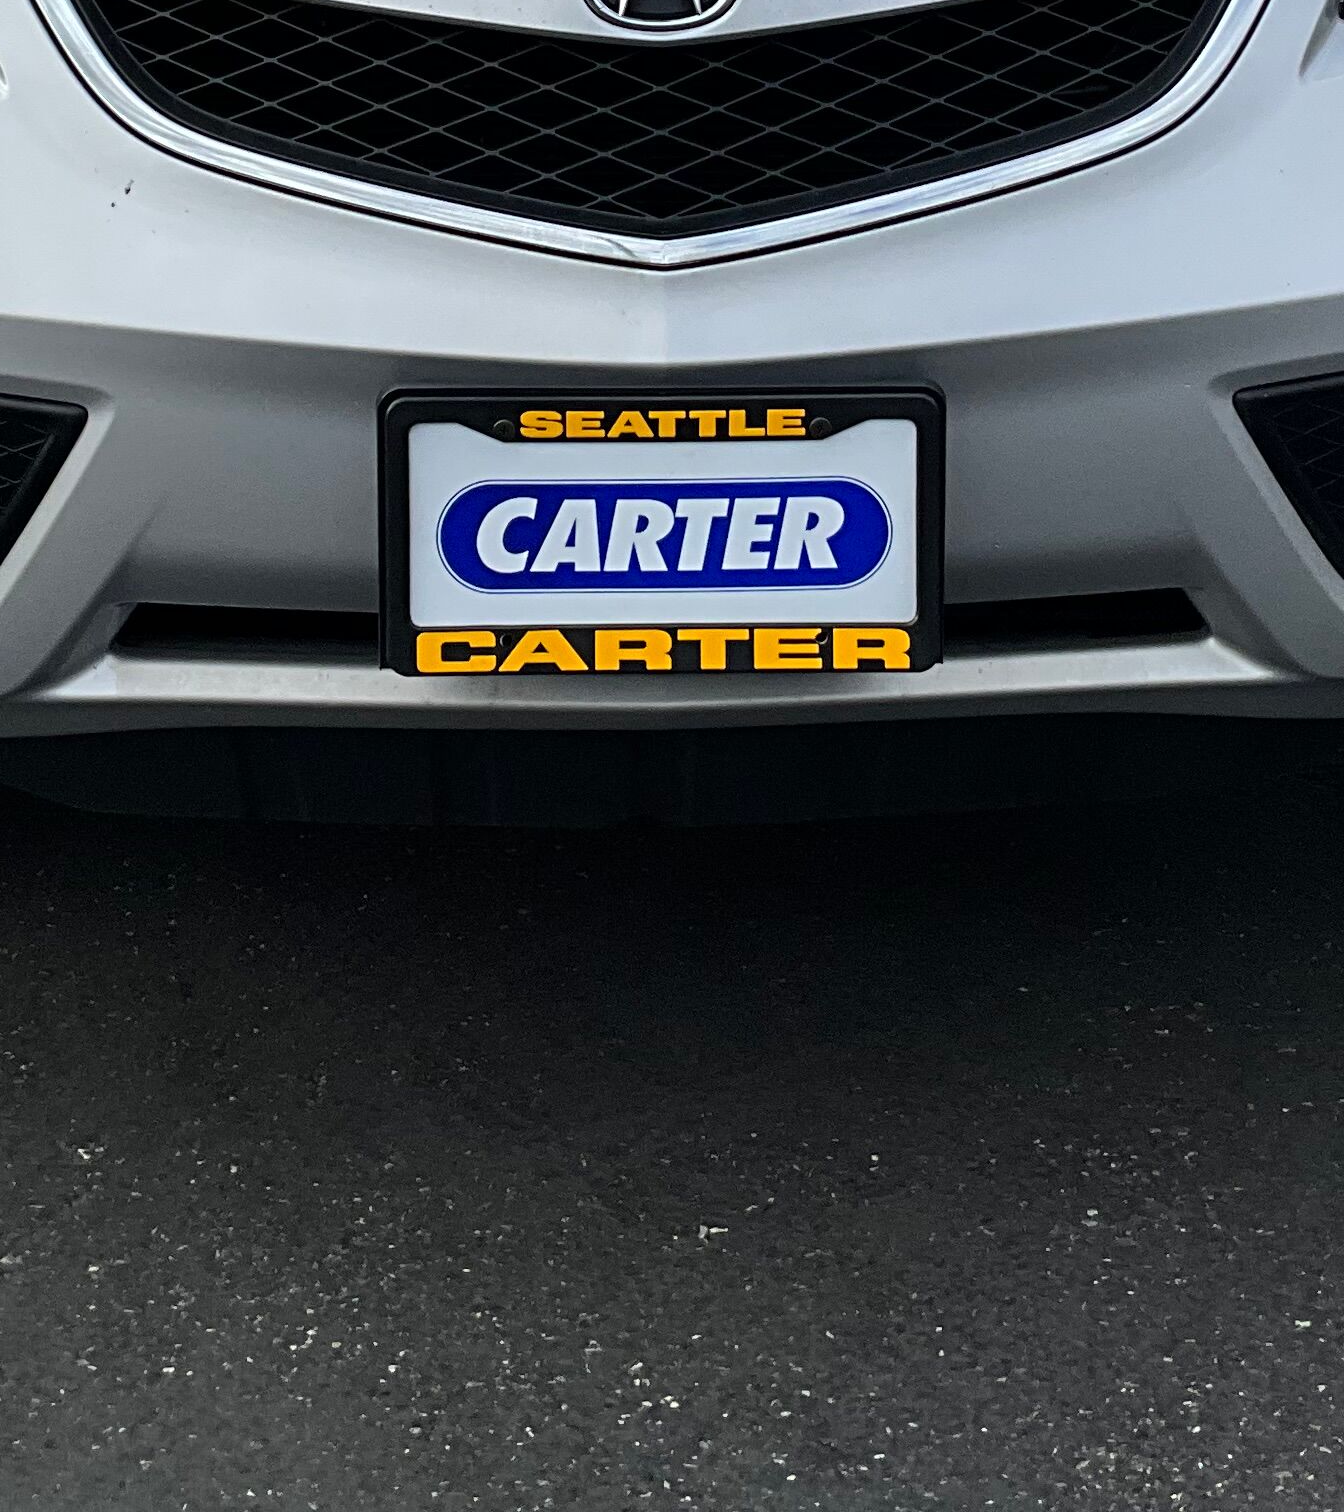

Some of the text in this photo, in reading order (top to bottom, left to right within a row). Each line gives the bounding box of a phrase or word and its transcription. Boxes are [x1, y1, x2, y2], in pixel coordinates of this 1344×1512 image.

[519, 408, 807, 439] SEATTLE
[475, 495, 846, 575] CARTER
[416, 627, 911, 674] CARTER
